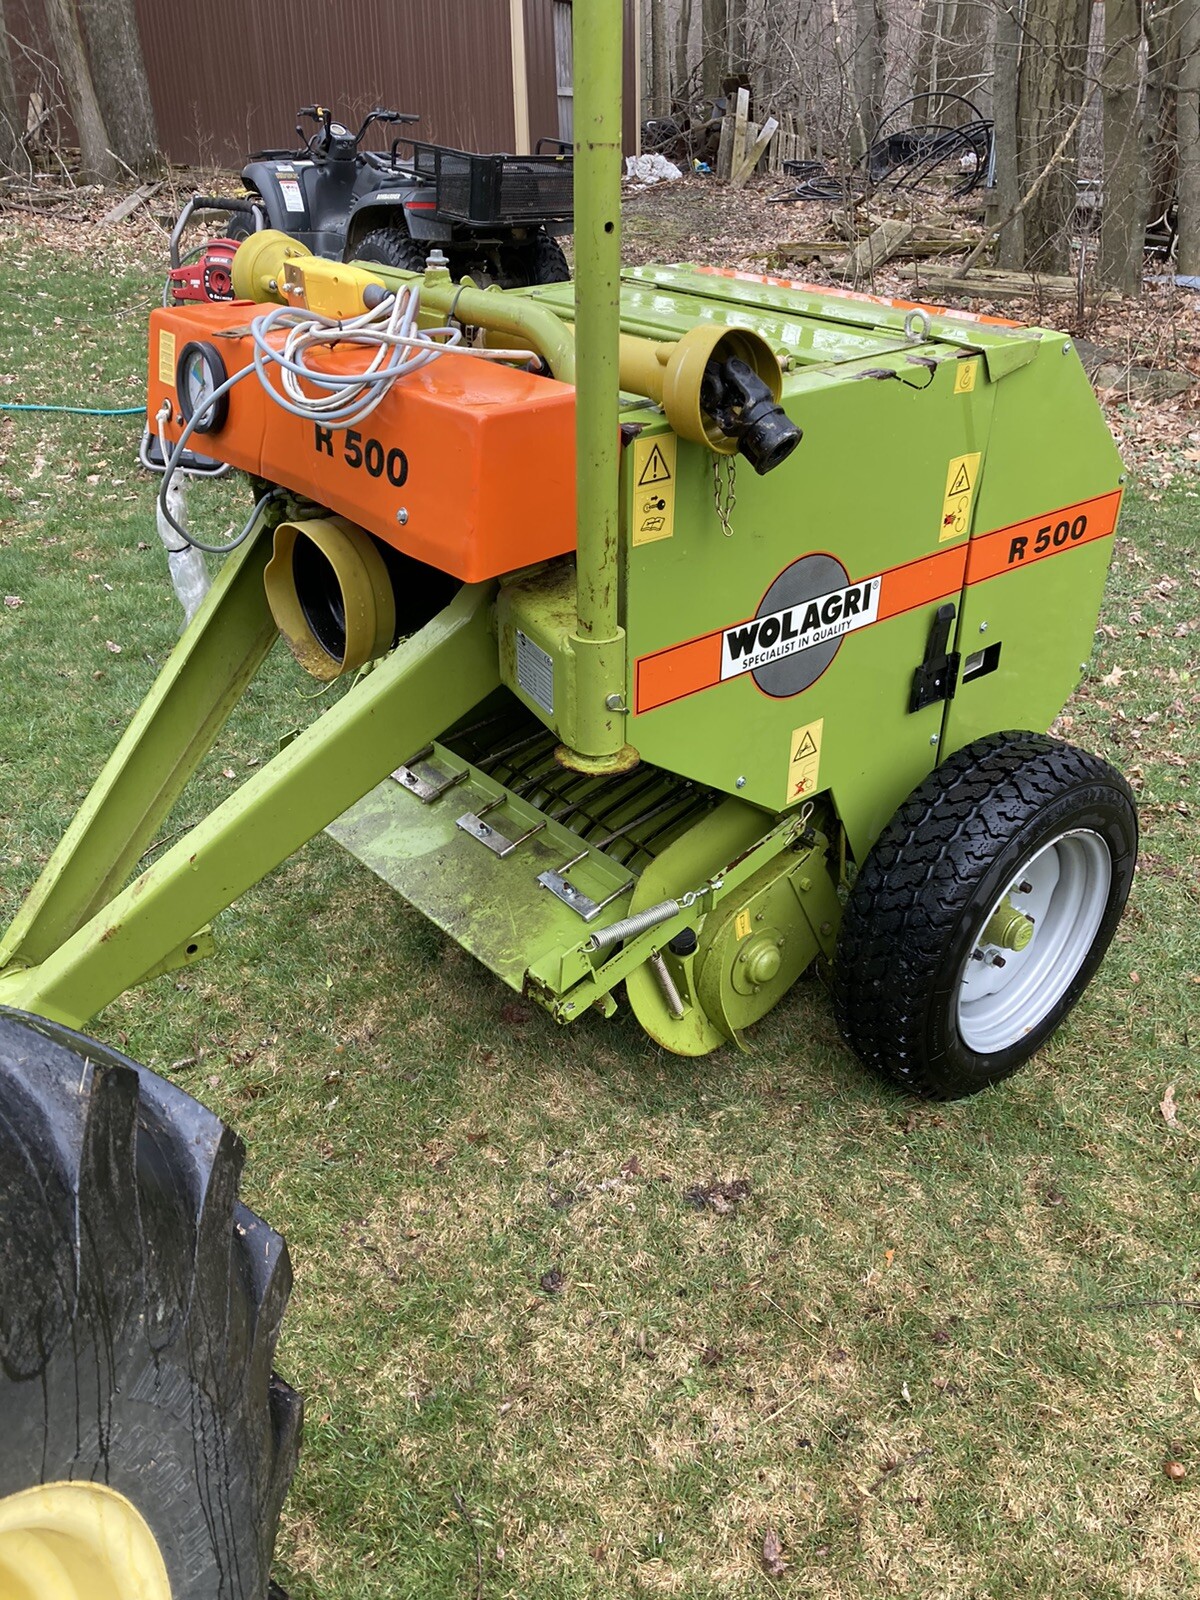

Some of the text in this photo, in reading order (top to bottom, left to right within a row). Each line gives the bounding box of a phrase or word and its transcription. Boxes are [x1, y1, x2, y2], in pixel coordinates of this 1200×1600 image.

[314, 422, 408, 488] R 500
[1008, 515, 1088, 564] R 500
[726, 582, 872, 661] WOLAGRI
[742, 619, 853, 669] SPECIALIST IN QUALITY
